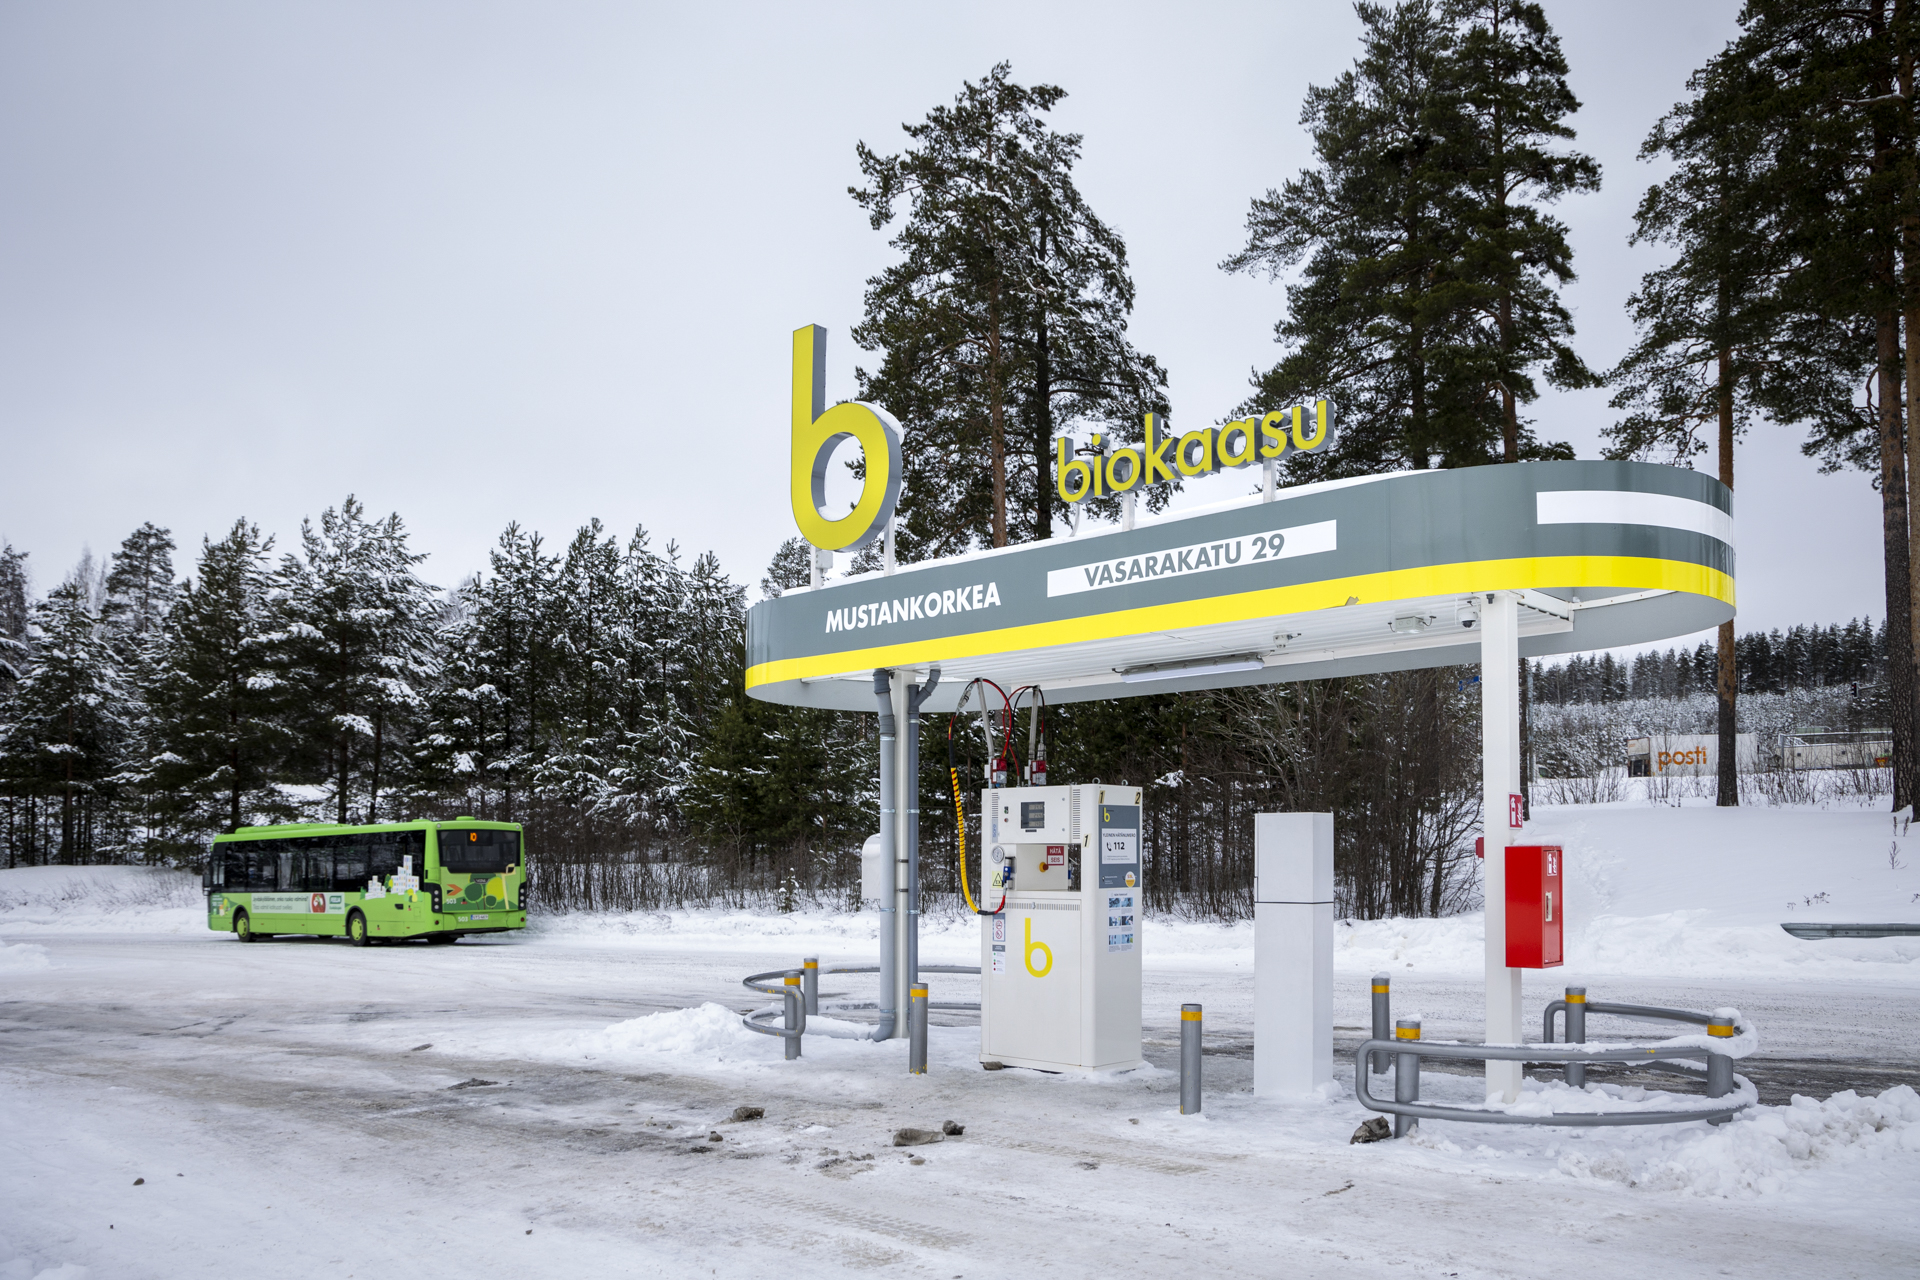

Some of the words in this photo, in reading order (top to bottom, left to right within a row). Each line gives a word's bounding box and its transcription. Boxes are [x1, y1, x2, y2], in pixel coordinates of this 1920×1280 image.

[791, 323, 893, 551] b
[1057, 399, 1330, 503] biokaasu
[1084, 541, 1242, 587] VASARAKATU
[1252, 533, 1285, 560] 29
[825, 581, 1002, 634] MUSTANKORKEA
[1658, 745, 1707, 772] posti
[1100, 791, 1104, 804] 1
[1134, 791, 1141, 804] 2
[1084, 834, 1089, 847] 1
[1113, 842, 1125, 850] 112
[1024, 917, 1053, 978] b
